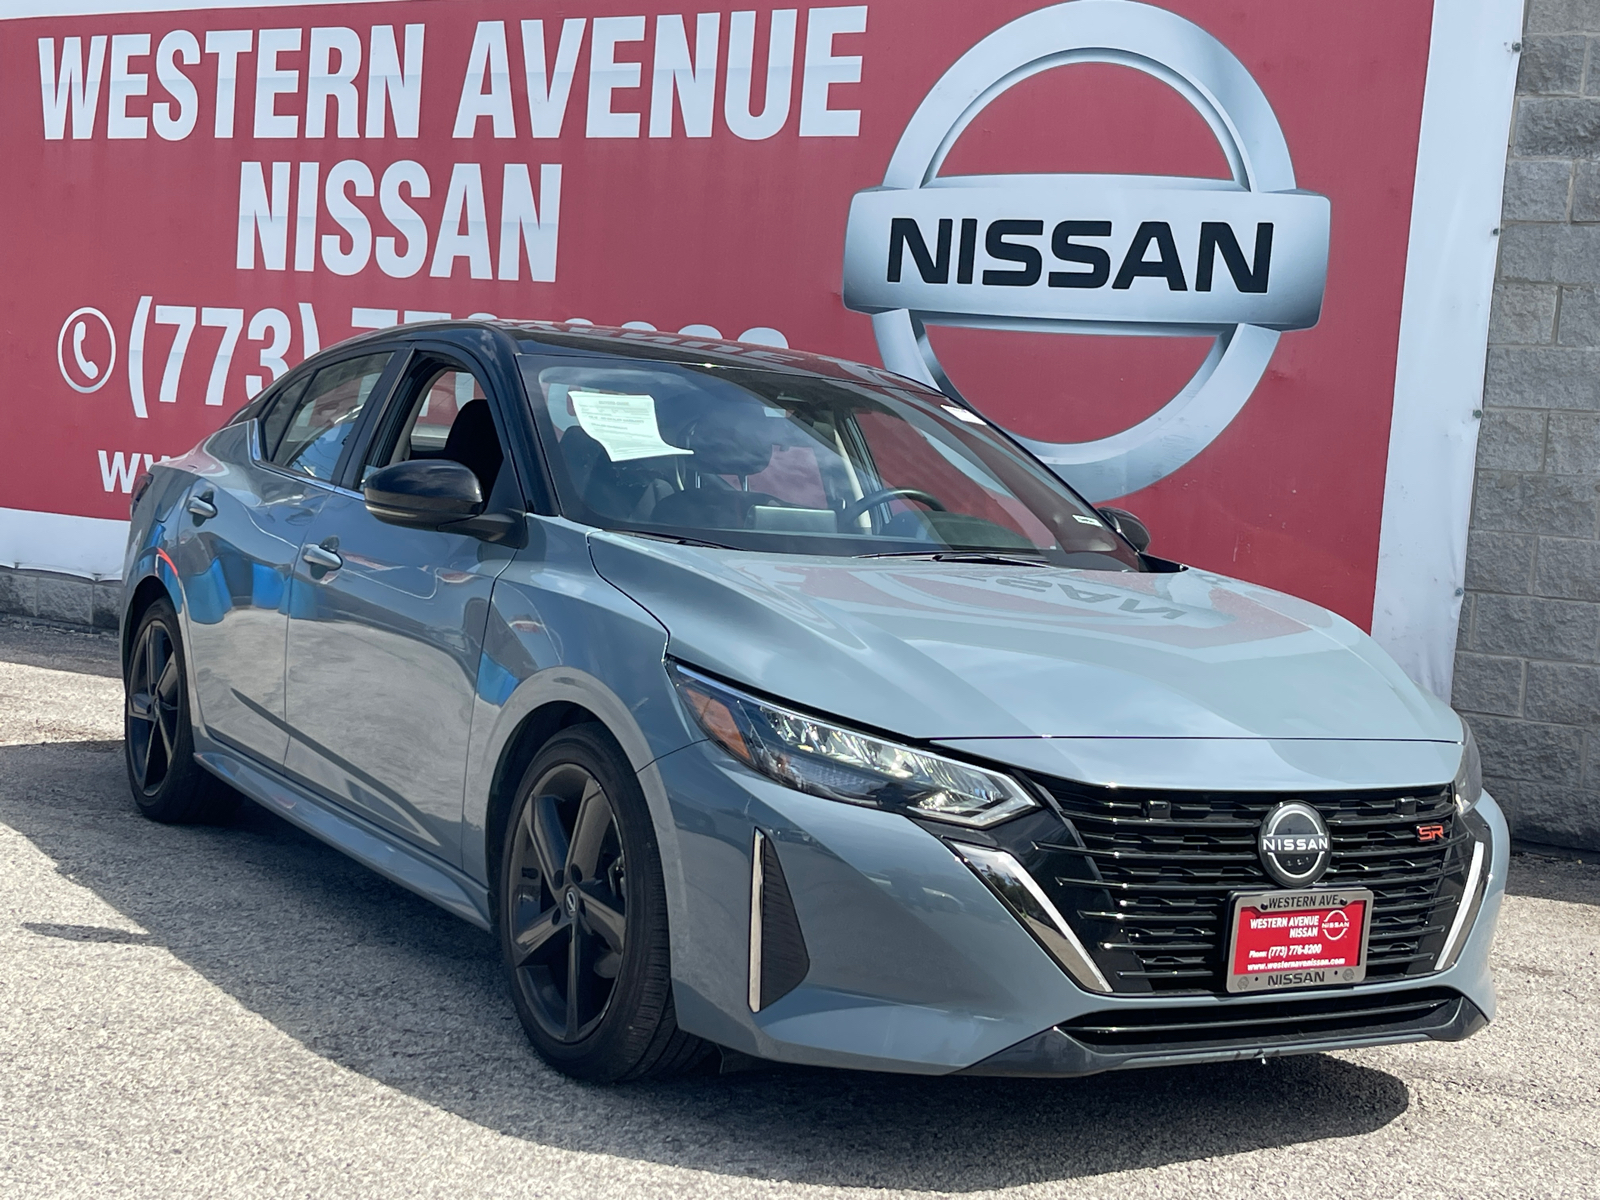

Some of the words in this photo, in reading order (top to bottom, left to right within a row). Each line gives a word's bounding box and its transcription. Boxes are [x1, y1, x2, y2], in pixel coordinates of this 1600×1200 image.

[38, 24, 426, 140] WESTERN
[452, 5, 868, 140] AVENUE
[236, 160, 562, 283] NISSAN
[887, 217, 1274, 293] NISSAN
[1418, 825, 1444, 841] SR
[1263, 838, 1328, 851] NISSAN
[1268, 897, 1317, 909] WESTERN
[1250, 917, 1288, 929] WESTERN
[1288, 915, 1319, 927] AVENUE
[1289, 927, 1318, 938] NISSAN
[1268, 946, 1287, 959] (773)
[1288, 944, 1322, 956] 776-8200
[1267, 971, 1325, 986] NISSAN
